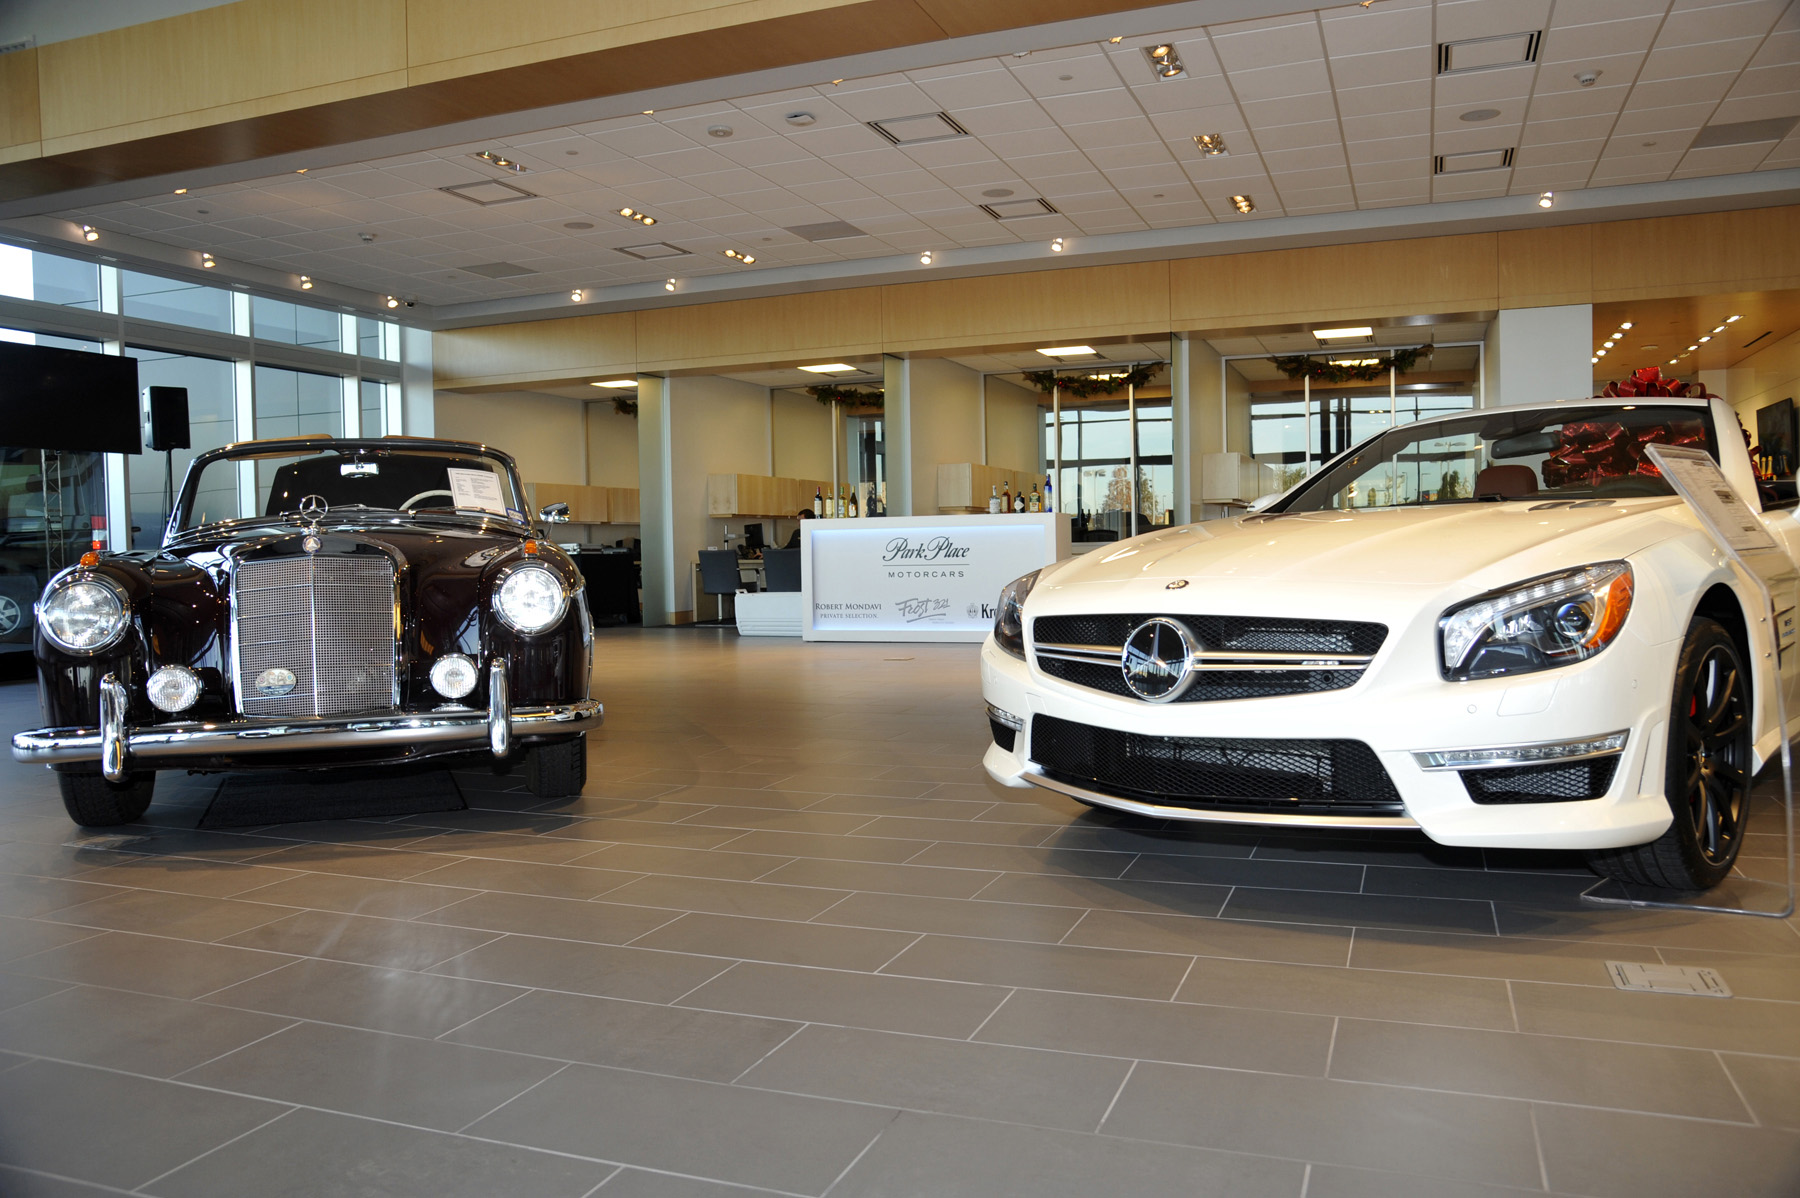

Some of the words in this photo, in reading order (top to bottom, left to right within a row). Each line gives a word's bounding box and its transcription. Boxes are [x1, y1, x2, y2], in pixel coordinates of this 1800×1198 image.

[882, 537, 925, 562] Park
[924, 536, 970, 561] Place
[932, 598, 951, 611] 321
